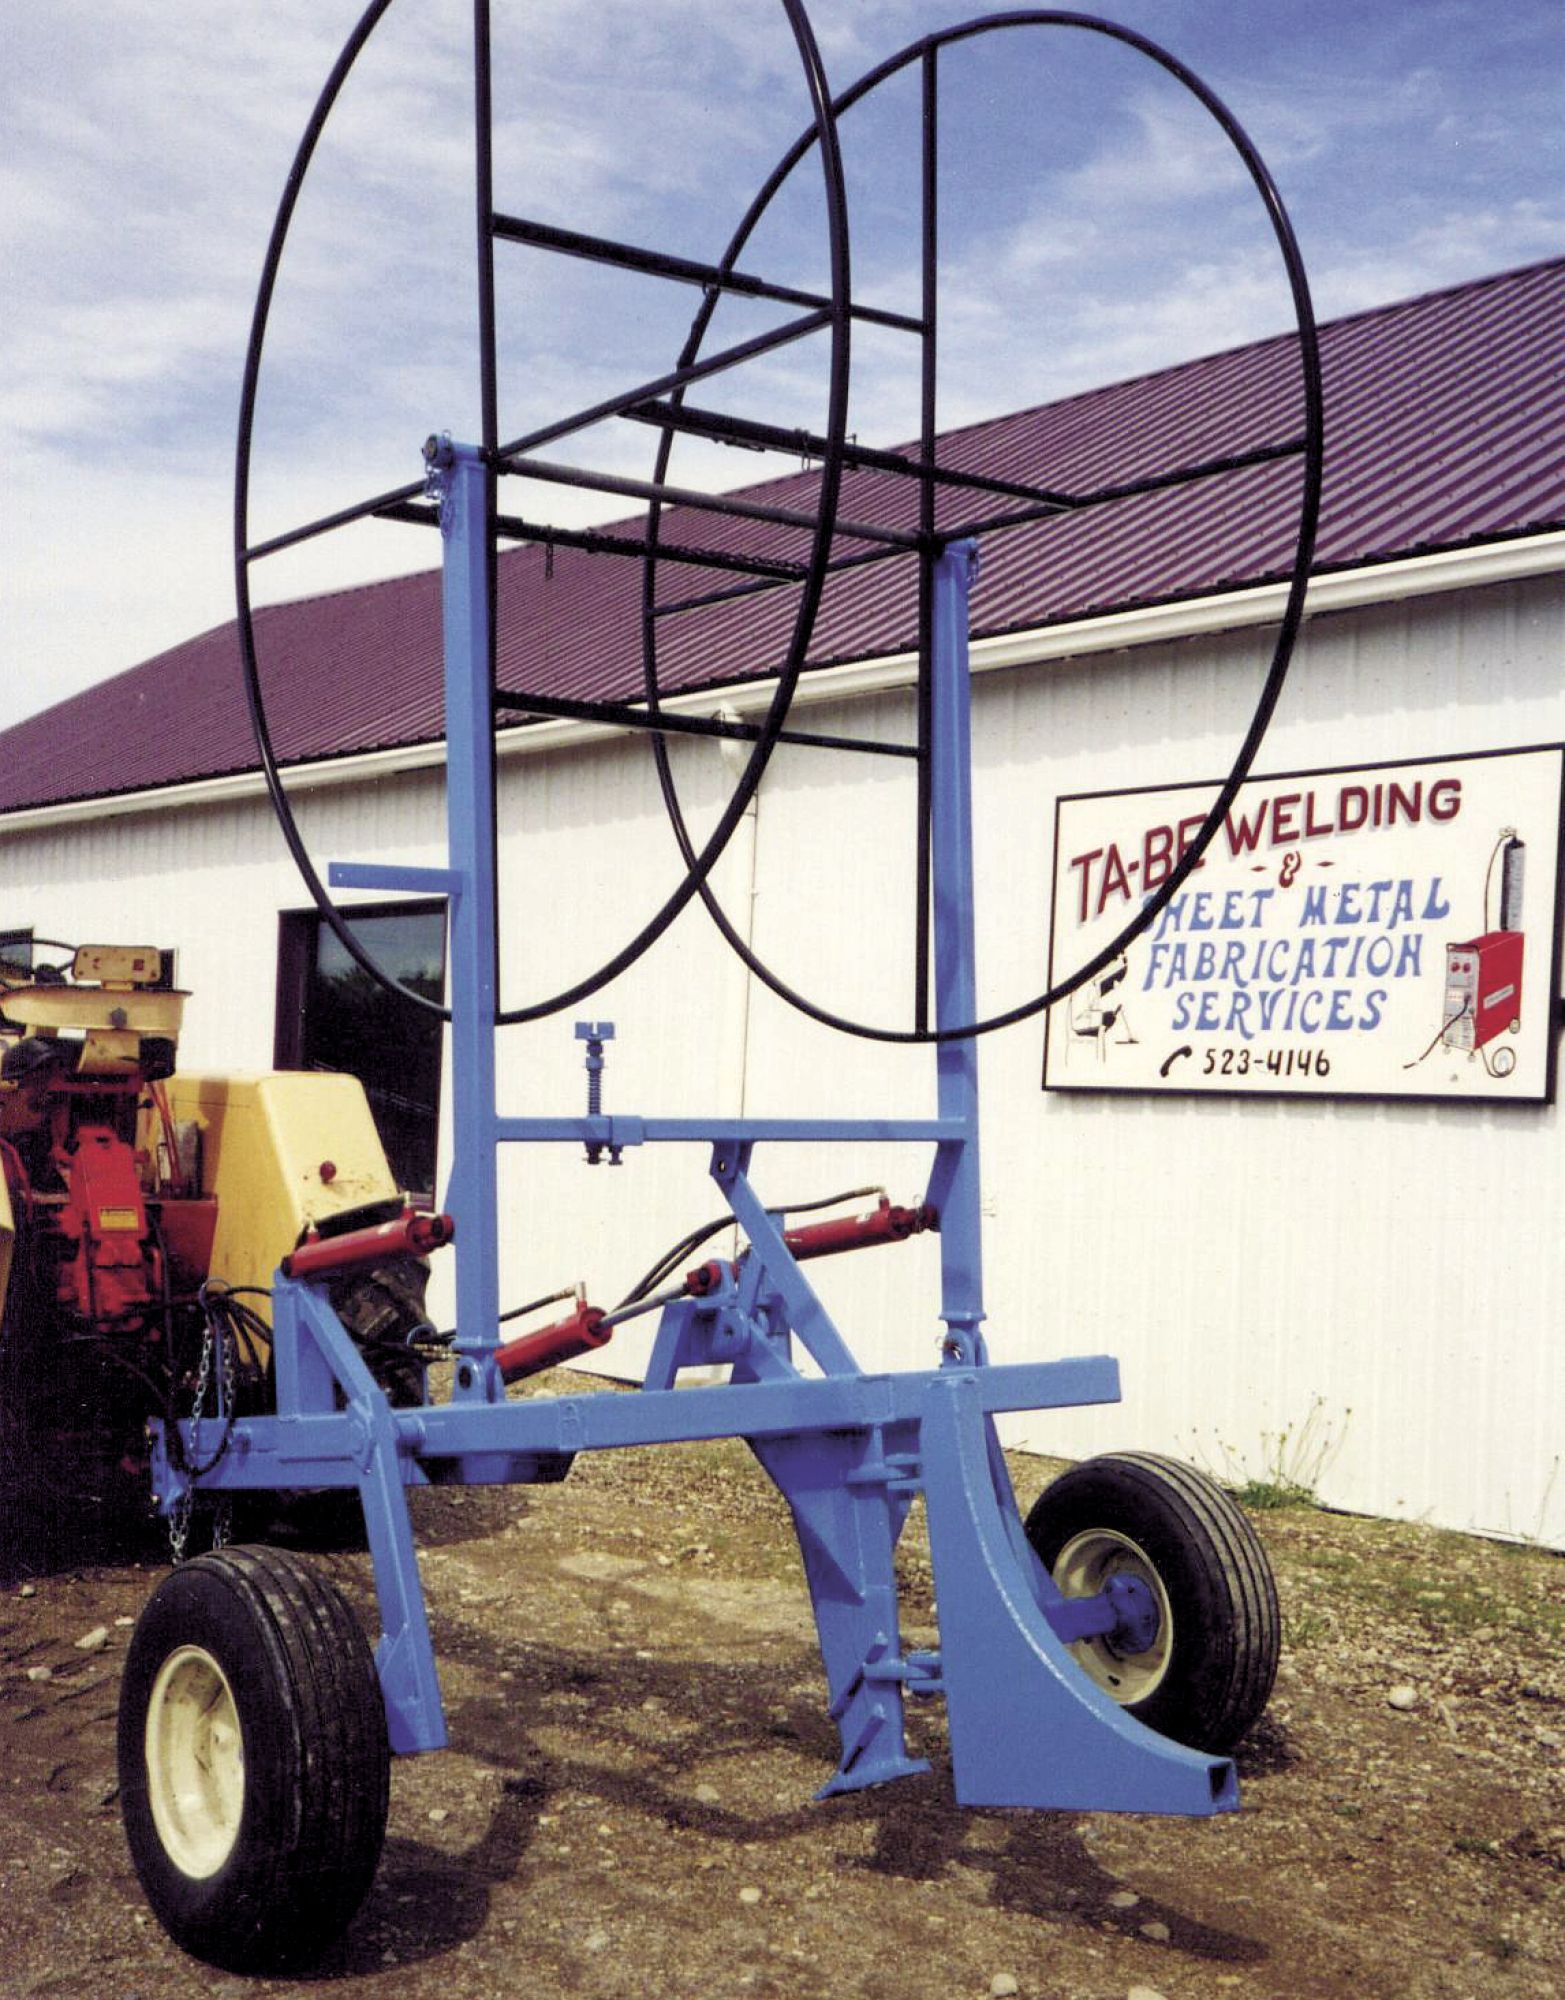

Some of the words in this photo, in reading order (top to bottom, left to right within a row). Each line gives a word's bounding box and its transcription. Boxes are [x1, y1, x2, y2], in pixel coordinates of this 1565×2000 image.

[1071, 813, 1208, 922] TA-BE
[1224, 779, 1462, 855] WELDING
[1278, 851, 1302, 888] &
[1300, 877, 1450, 929] METAL
[1143, 933, 1424, 991] FABRICATION
[1171, 988, 1388, 1040] SERVICES
[1203, 1048, 1331, 1077] 523-4146
